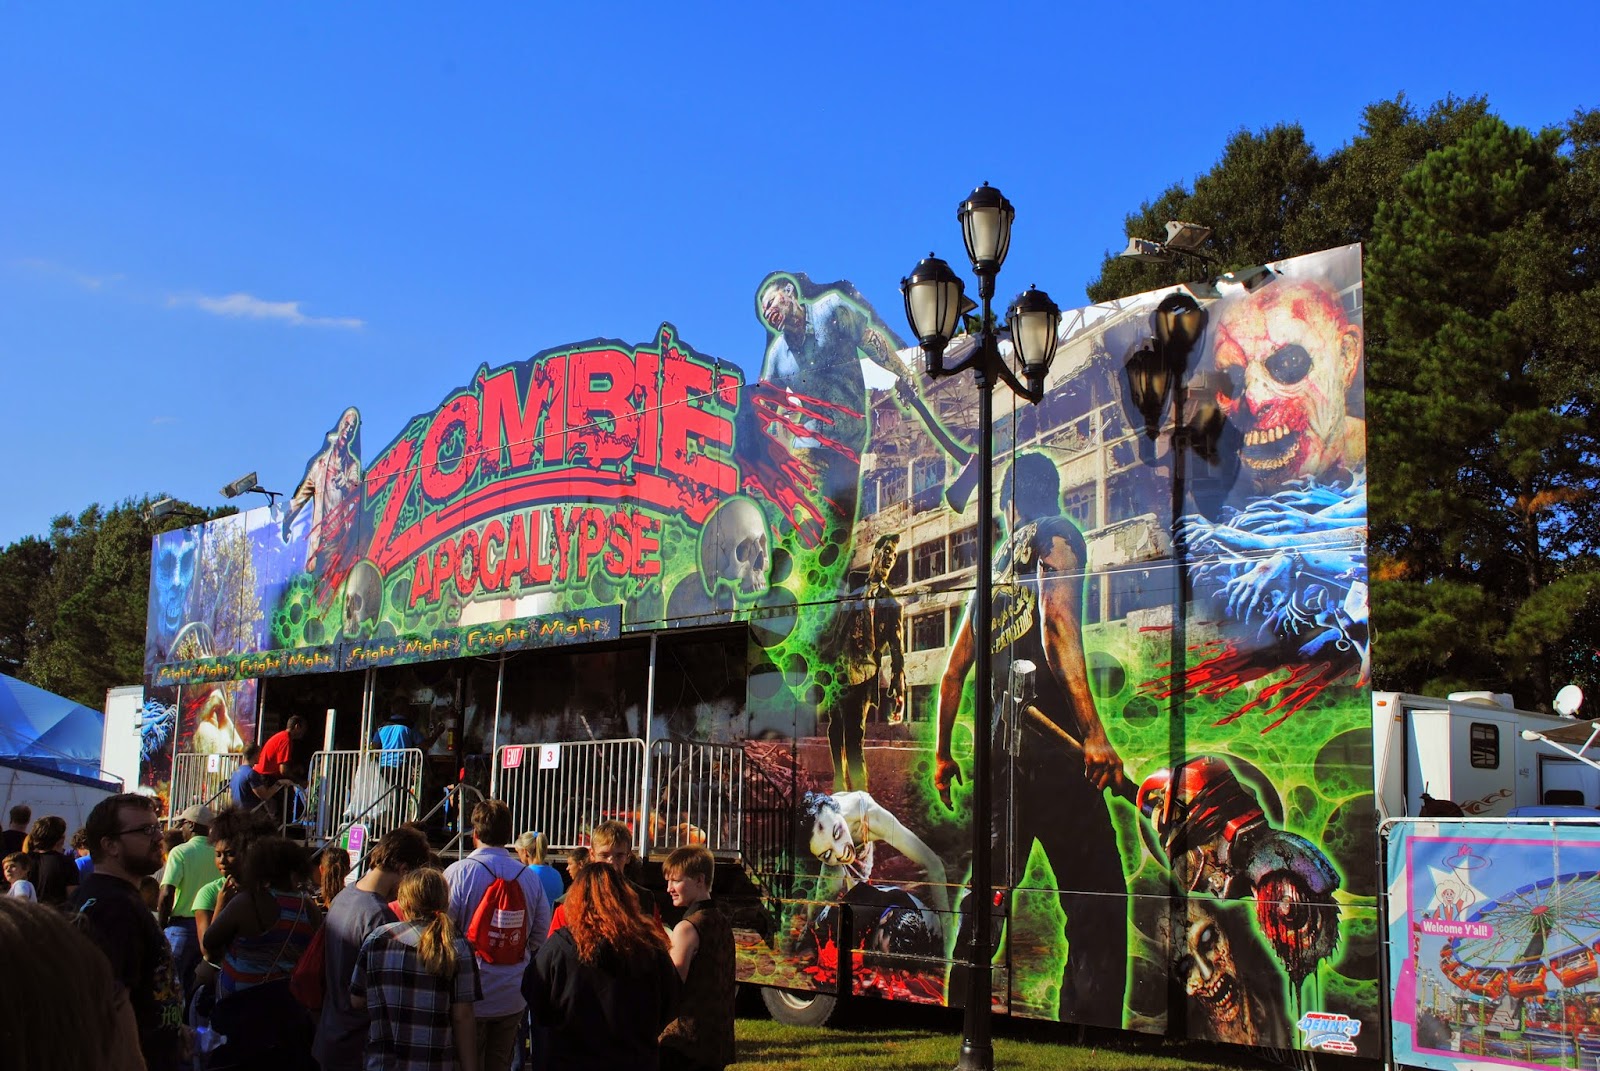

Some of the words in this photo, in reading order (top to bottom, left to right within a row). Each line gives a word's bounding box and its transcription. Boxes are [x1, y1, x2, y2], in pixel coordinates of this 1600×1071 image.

[365, 341, 740, 573] ZOMBIE
[410, 507, 661, 607] APOCALYPSE
[352, 645, 396, 662] Fright
[404, 638, 452, 656] Night
[468, 626, 531, 649] Fright
[540, 618, 603, 639] Night
[160, 668, 193, 680] Fright
[197, 663, 229, 677] Night
[240, 658, 281, 674] Fright
[288, 652, 330, 668] Night
[506, 748, 521, 765] EXIT
[547, 751, 553, 762] 3
[1422, 920, 1463, 935] Welcome
[1464, 924, 1488, 937] Y'all!
[1301, 1018, 1360, 1035] DENNY'S
